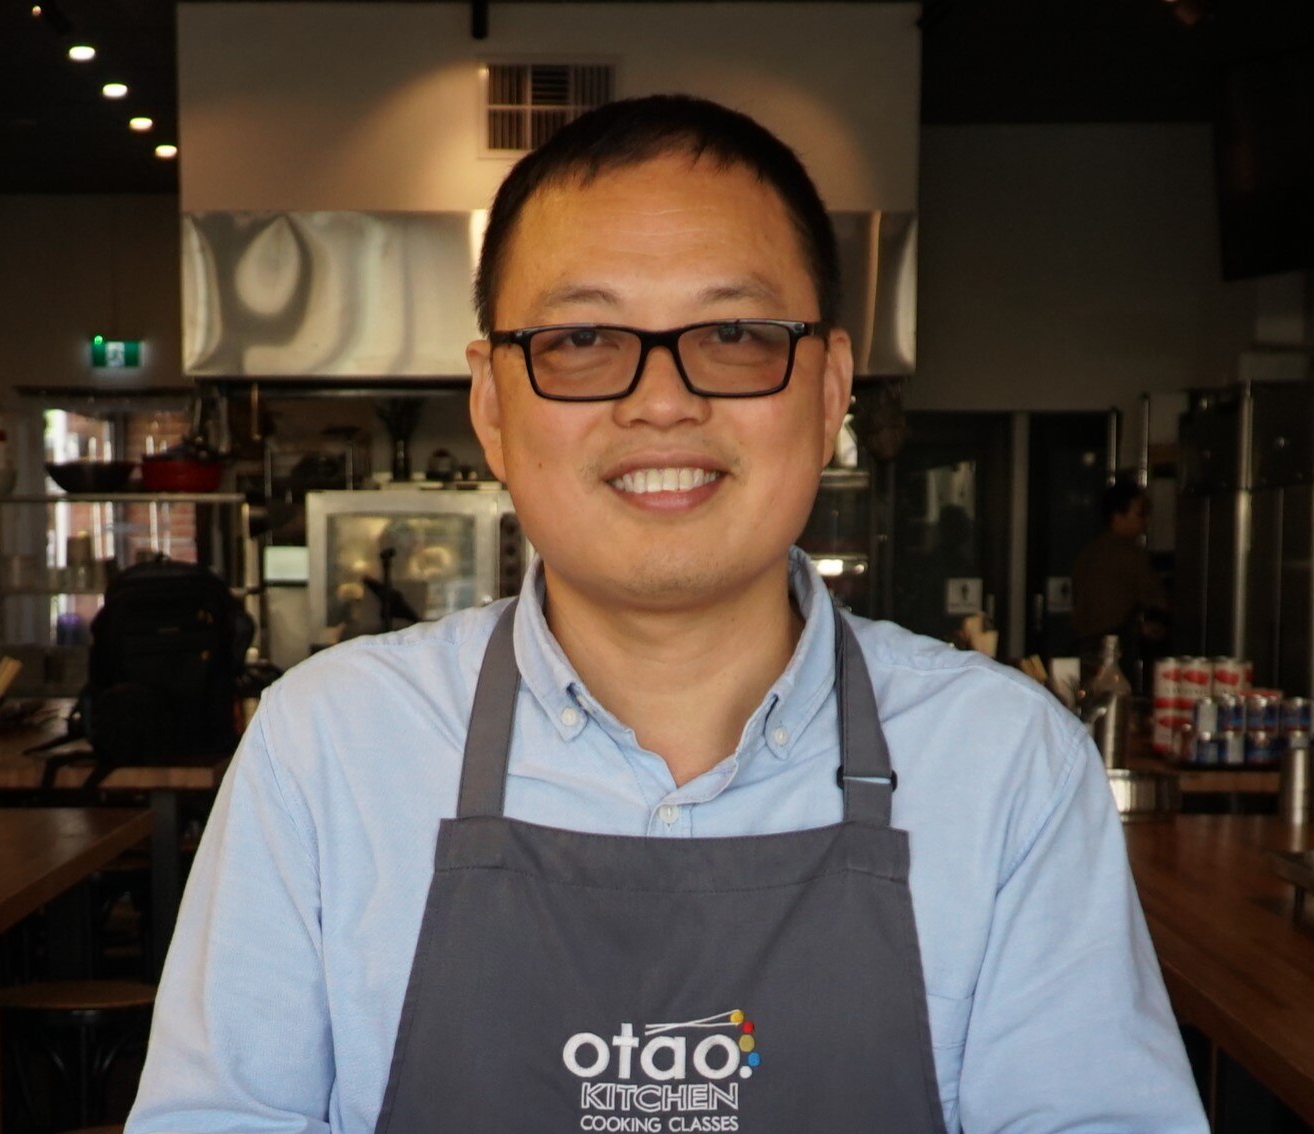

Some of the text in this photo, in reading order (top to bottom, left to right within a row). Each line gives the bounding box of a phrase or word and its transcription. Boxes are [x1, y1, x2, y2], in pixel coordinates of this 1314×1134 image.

[562, 1023, 740, 1081] otao
[581, 1082, 739, 1112] KITCHEN
[580, 1115, 739, 1133] COOKING CLASSES
